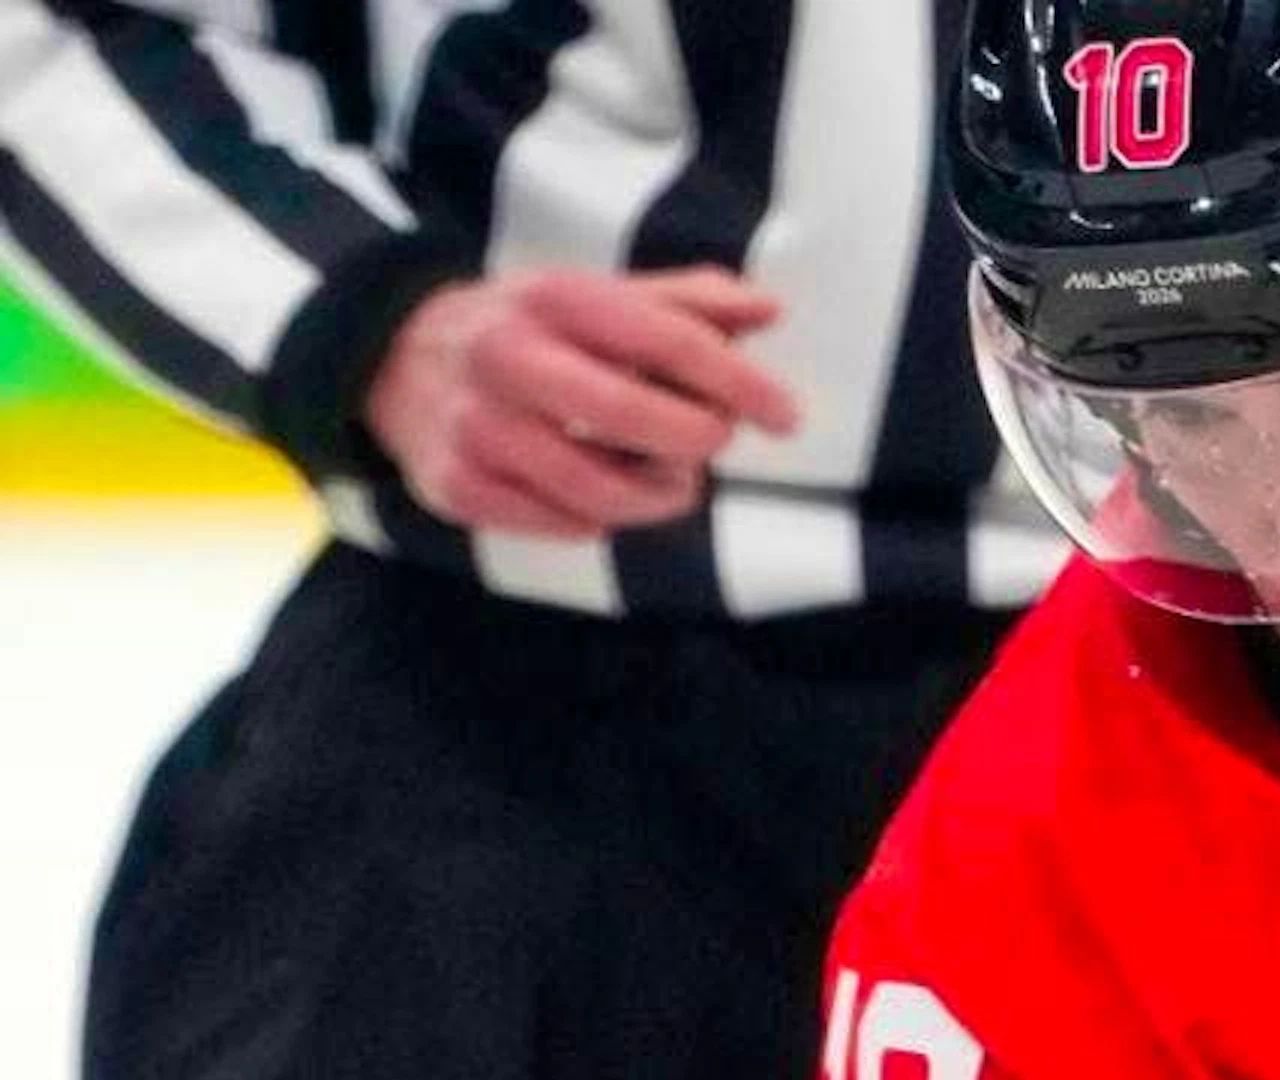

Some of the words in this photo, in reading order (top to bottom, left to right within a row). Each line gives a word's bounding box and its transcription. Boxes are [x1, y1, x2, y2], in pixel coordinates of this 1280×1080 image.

[1063, 37, 1194, 172] 10
[1064, 267, 1150, 290] MILANO
[1154, 260, 1250, 288] CORTINA
